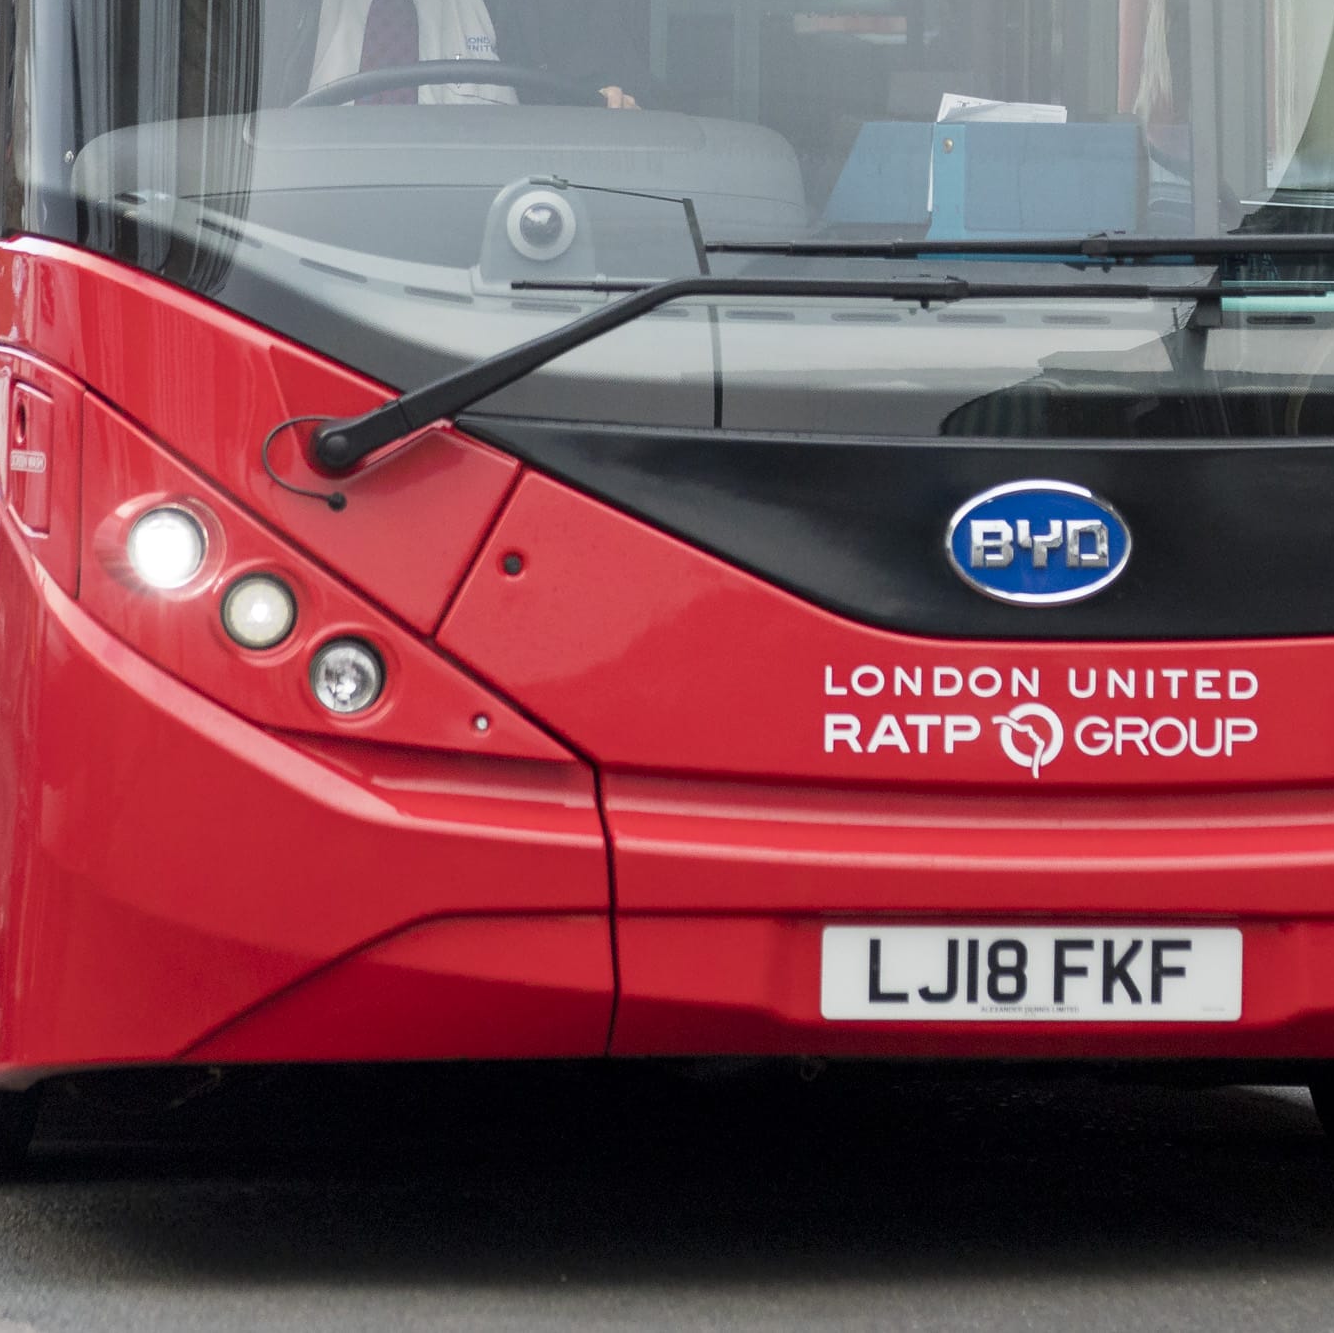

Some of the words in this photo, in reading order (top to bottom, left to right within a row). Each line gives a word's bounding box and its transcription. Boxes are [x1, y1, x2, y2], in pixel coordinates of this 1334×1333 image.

[970, 519, 1109, 568] BYD
[825, 665, 1040, 698] LONDON
[1068, 668, 1258, 699] UNITED
[824, 714, 981, 754] RATP
[1074, 715, 1258, 757] GROUP
[869, 939, 1028, 1004] LJ18
[1053, 939, 1192, 1005] FKF
